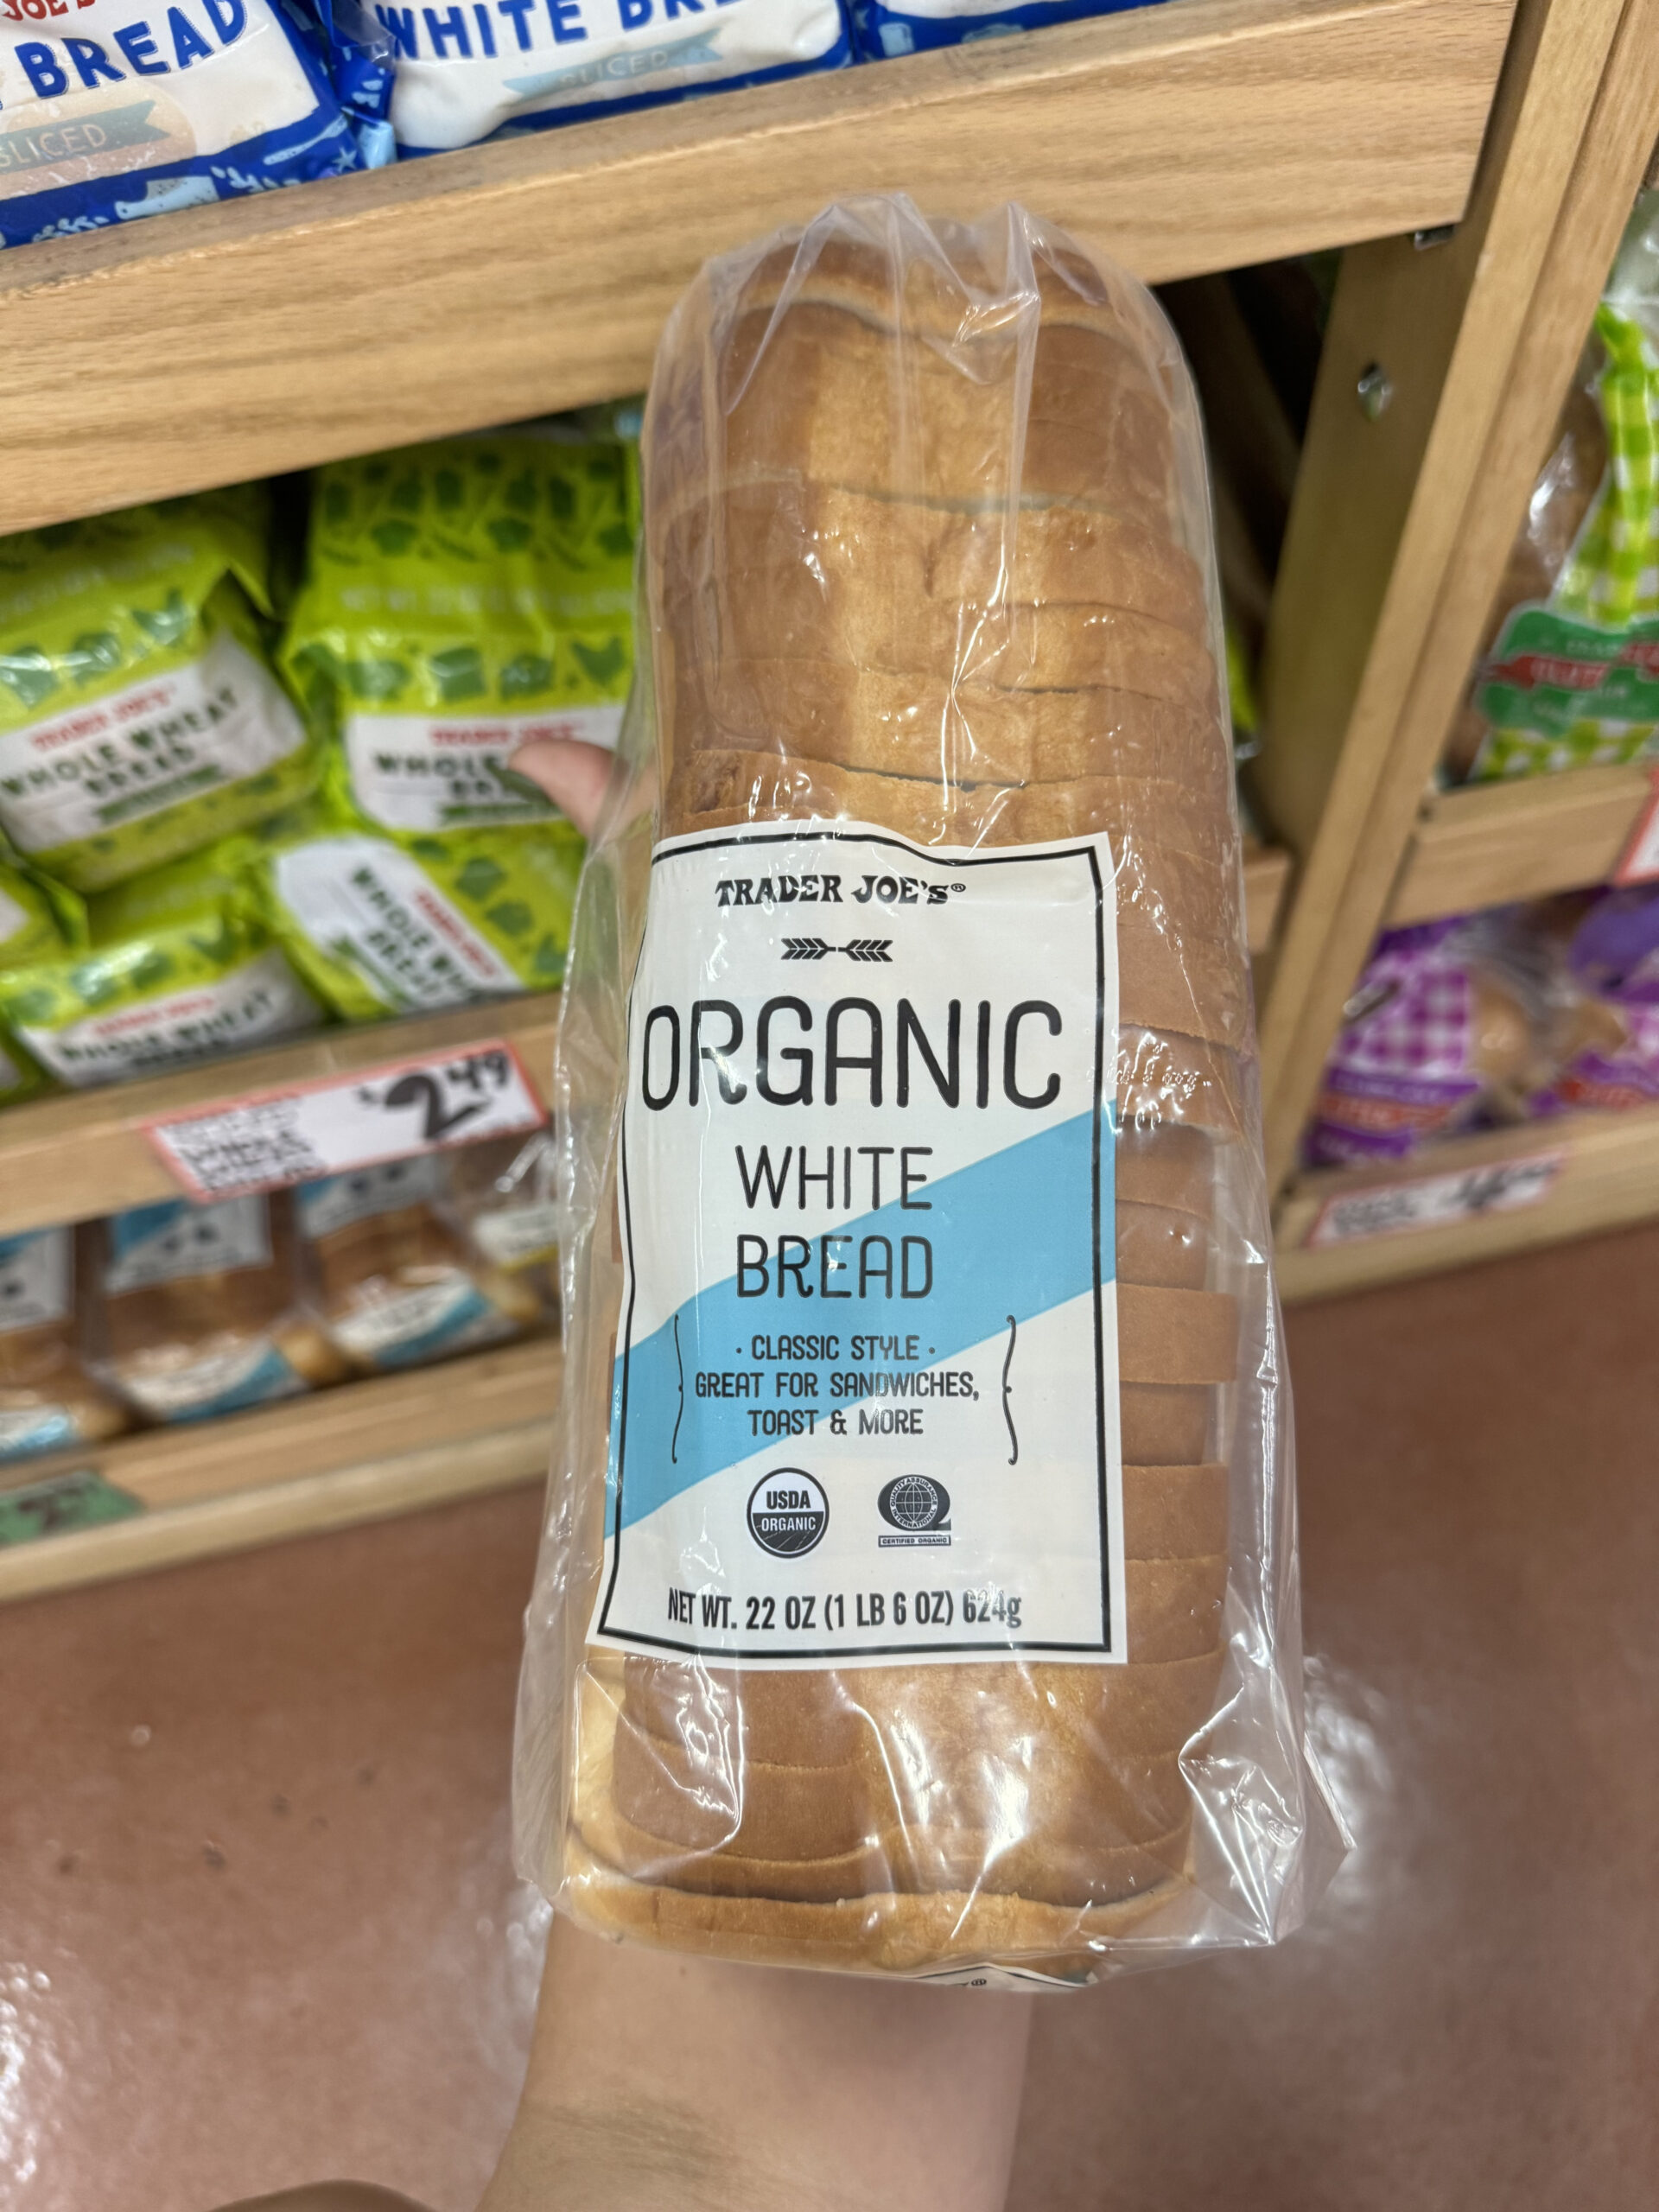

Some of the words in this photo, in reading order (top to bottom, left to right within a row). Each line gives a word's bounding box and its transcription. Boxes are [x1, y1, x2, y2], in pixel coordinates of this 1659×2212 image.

[374, 0, 587, 60] WHITE
[15, 0, 247, 99] BREAD
[715, 874, 843, 907] TRADER
[642, 995, 1062, 1111] ORGANIC
[735, 1146, 932, 1210] WHITE
[737, 1235, 932, 1299] BREAD
[752, 1335, 839, 1361] CLASSIC
[850, 1335, 920, 1361] STYLE
[695, 1372, 764, 1398] GREAT
[776, 1372, 818, 1397] FOR
[830, 1371, 979, 1402] SANDWICHES,
[747, 1409, 819, 1436] TOAST
[830, 1409, 847, 1435] &
[859, 1408, 924, 1434] MORE
[766, 1490, 810, 1510] USDA
[890, 1478, 906, 1507] QUALITY
[906, 1477, 938, 1505] ASSURANCE
[761, 1516, 816, 1532] ORGANIC
[892, 1508, 937, 1529] INTERNATIONAL
[668, 1586, 696, 1625] NET
[702, 1594, 738, 1629] WT.
[746, 1596, 775, 1630] 22
[785, 1594, 816, 1630] OZ
[824, 1593, 844, 1630] (1
[856, 1592, 885, 1627] LB
[893, 1592, 906, 1624] 6
[915, 1590, 954, 1626] OZ)
[963, 1589, 1021, 1628] 624g
